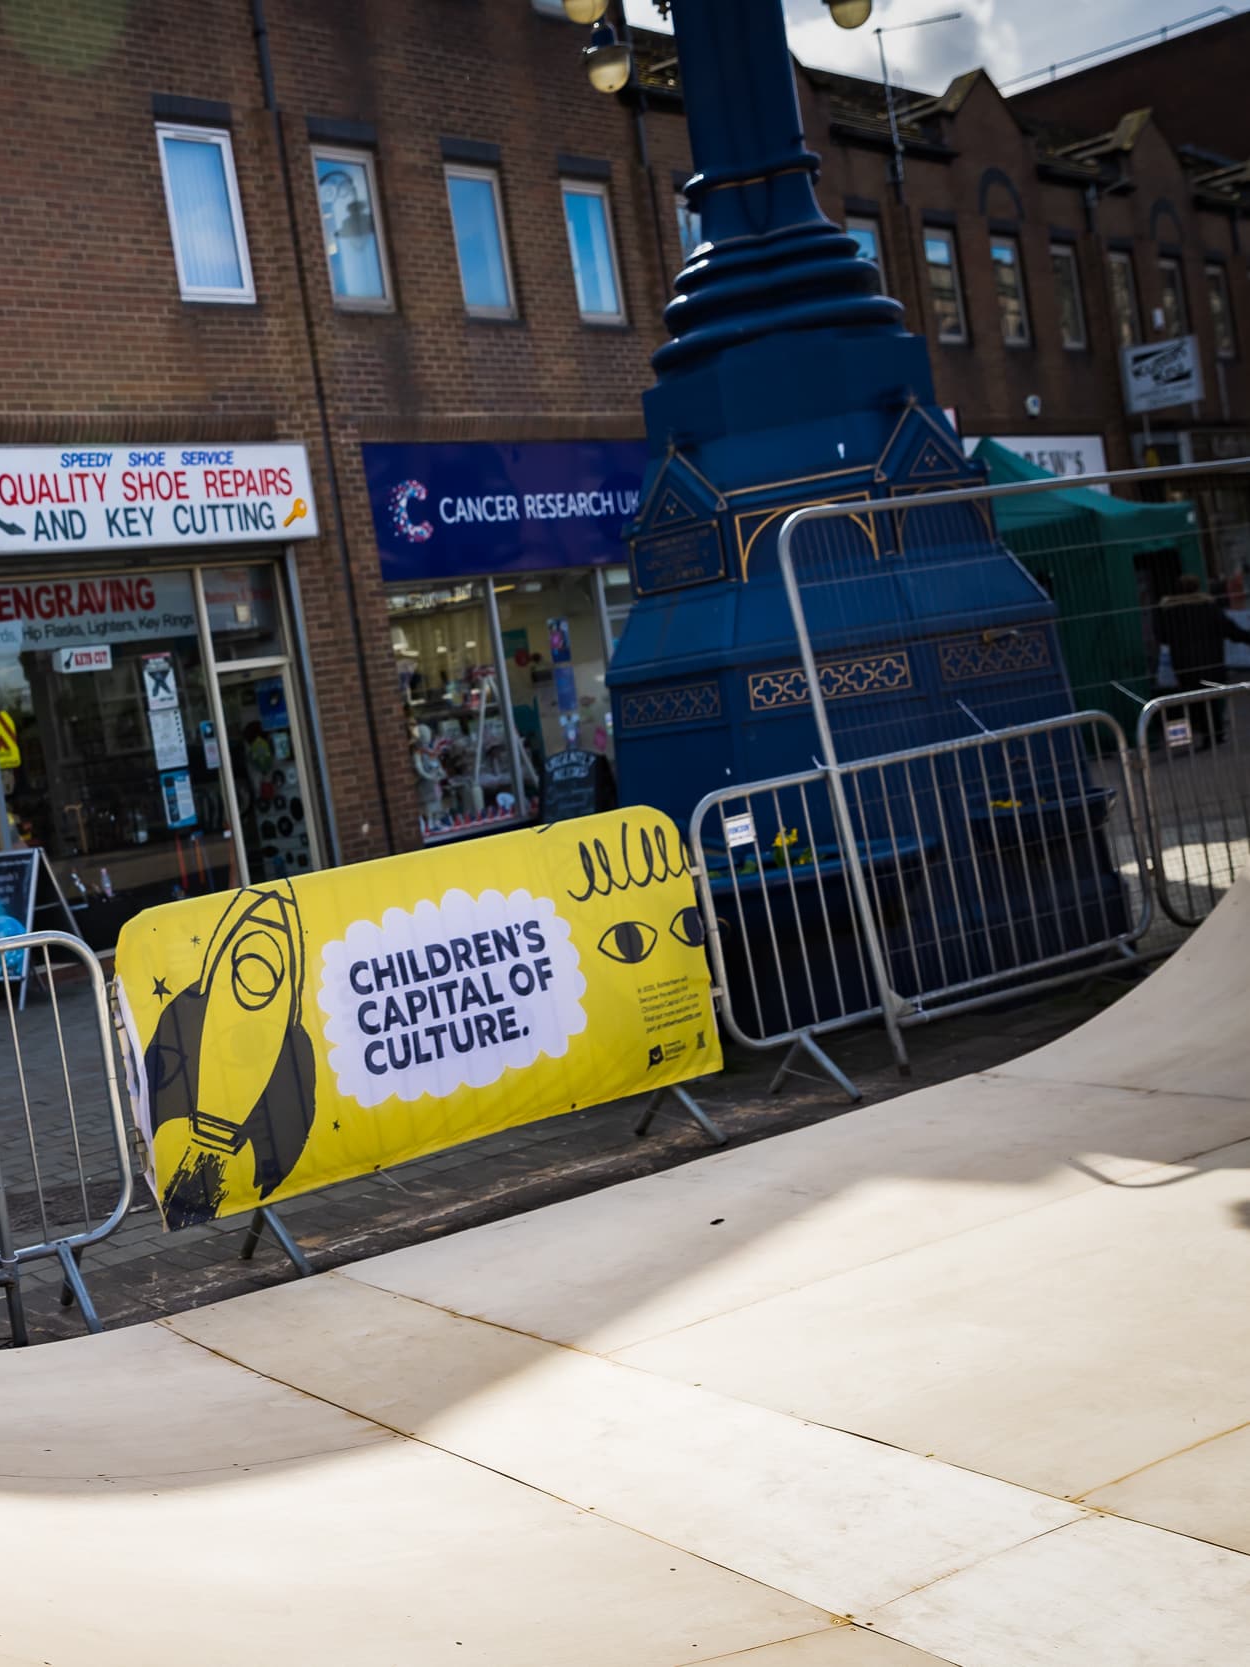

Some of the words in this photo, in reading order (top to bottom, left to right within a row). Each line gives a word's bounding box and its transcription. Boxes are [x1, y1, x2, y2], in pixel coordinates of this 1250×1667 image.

[60, 452, 113, 468] SPEEDY
[128, 451, 166, 467] SHOE
[181, 450, 234, 466] SERVICE
[122, 470, 189, 501] SHOE
[204, 467, 293, 499] REPAIRS
[33, 509, 87, 542] AND
[105, 506, 154, 538] KEY
[173, 501, 276, 536] CUTTING
[439, 494, 520, 524] CANCER
[523, 491, 615, 520] RESEARCH
[87, 618, 137, 637] Lighters,
[139, 615, 159, 632] Key
[163, 613, 195, 630] Rings
[349, 920, 546, 996] CHILDREN'S
[357, 971, 505, 1036] CAPITAL
[508, 956, 554, 997] OF
[364, 1005, 530, 1076] CULTURE.
